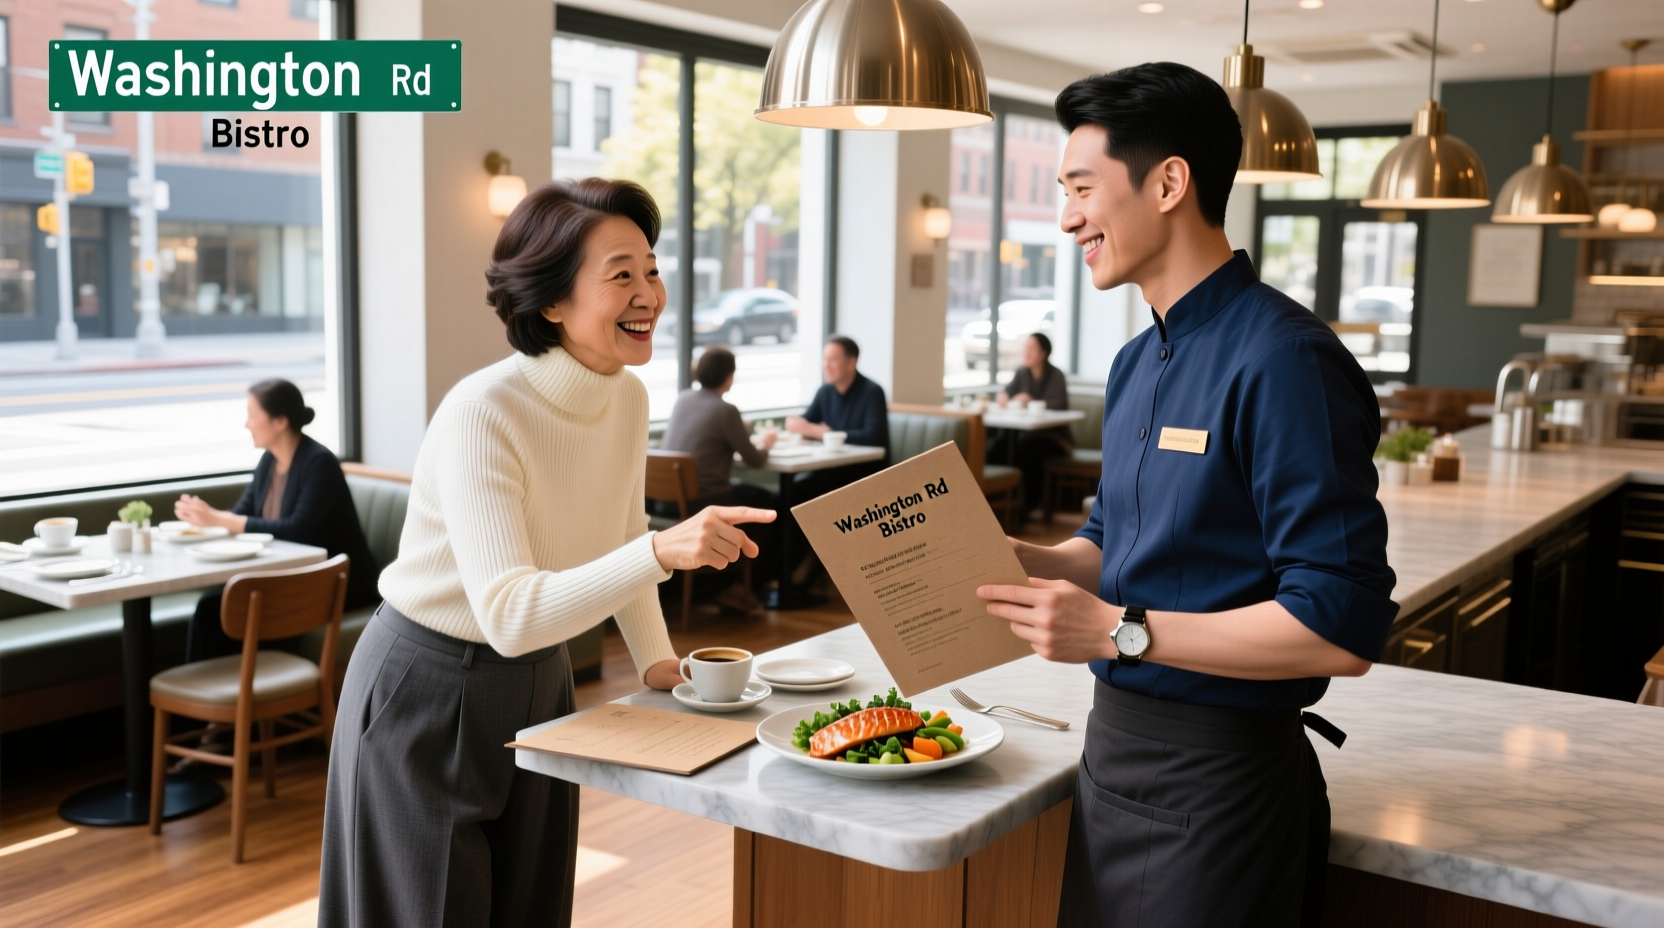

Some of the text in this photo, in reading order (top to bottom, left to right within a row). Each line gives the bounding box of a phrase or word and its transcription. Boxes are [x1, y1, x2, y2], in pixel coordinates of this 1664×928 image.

[67, 48, 432, 111] Washington Rd
[211, 118, 310, 148] Bistro
[833, 477, 949, 535] Washington Rd
[878, 512, 926, 538] Bistro
